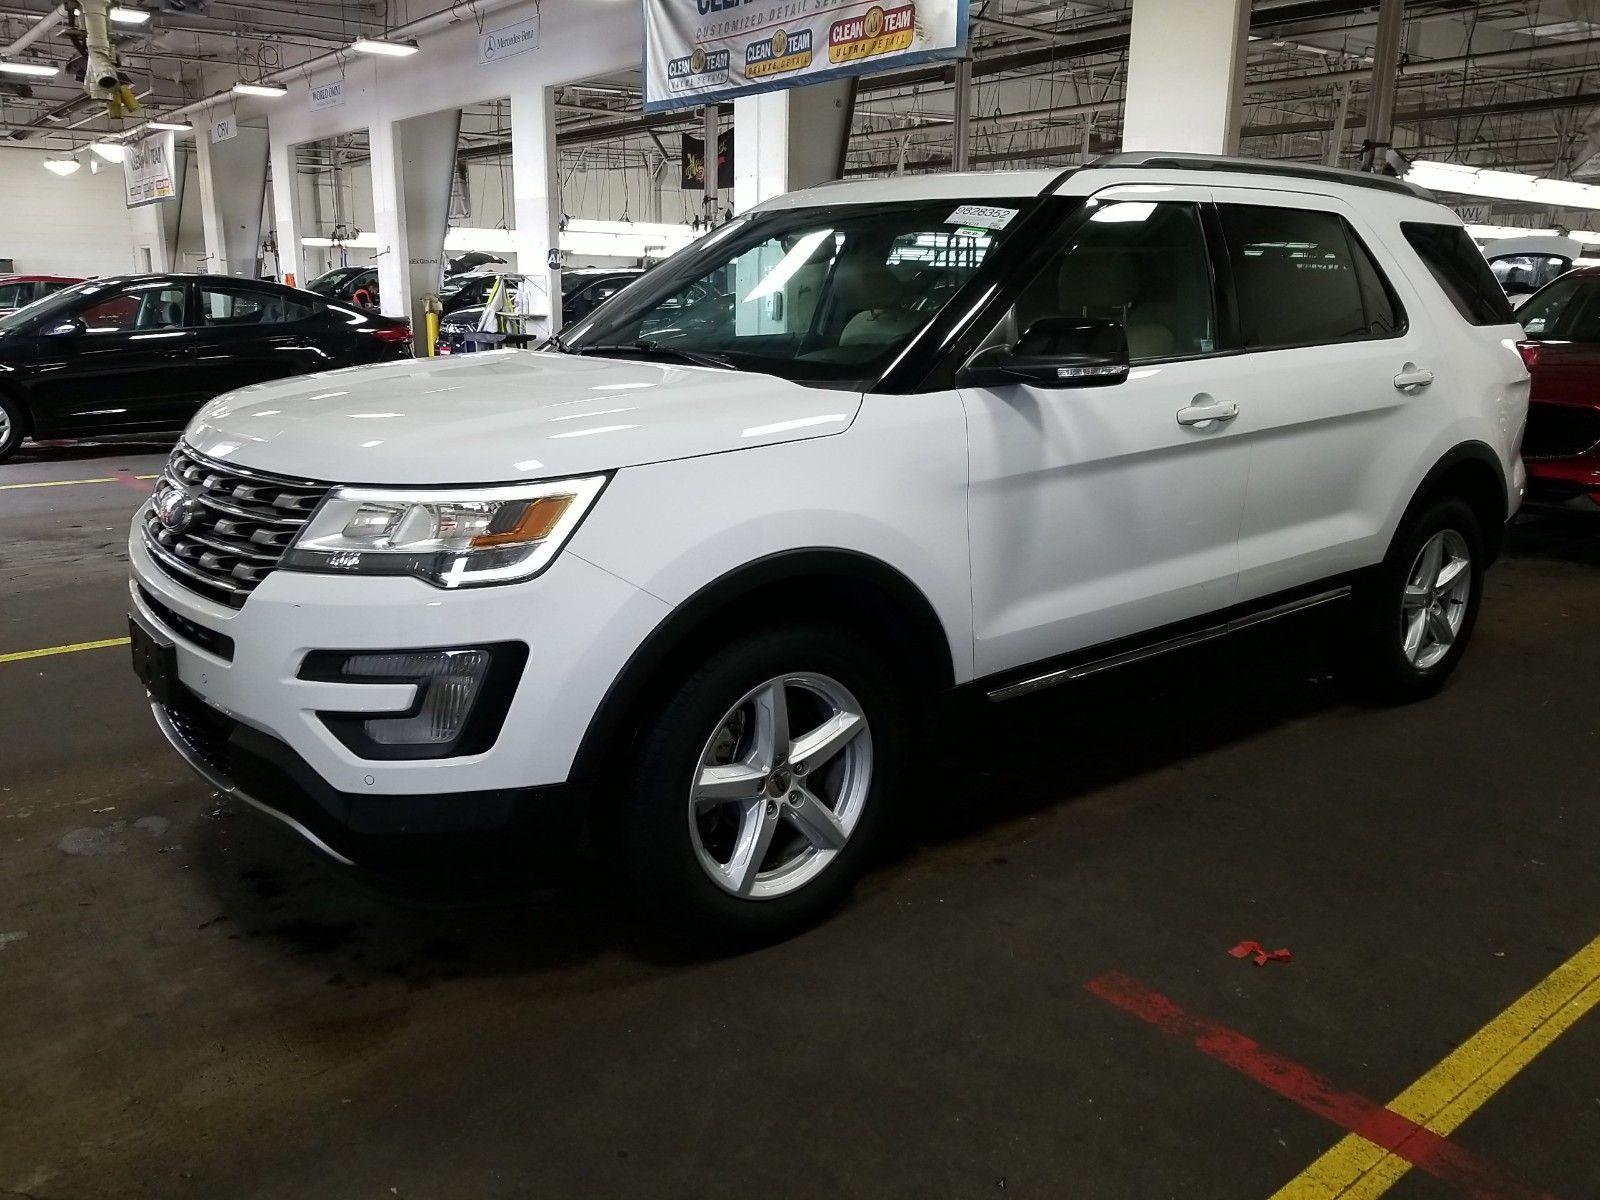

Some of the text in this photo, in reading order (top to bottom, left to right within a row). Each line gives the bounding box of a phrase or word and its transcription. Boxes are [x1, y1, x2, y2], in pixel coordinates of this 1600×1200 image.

[696, 12, 764, 40] CUSTOMIZED
[769, 2, 807, 20] DETAIL
[832, 20, 864, 43] CLEAN
[884, 9, 912, 32] TEAM
[497, 29, 534, 49] Mercedes-Benz
[747, 41, 771, 62] CLEAN
[788, 32, 811, 53] TEAM
[836, 35, 906, 57] ULTRA DETAIL
[668, 59, 690, 77] CLEAN
[706, 53, 728, 70] TEAM
[748, 62, 777, 75] DELUXE
[955, 206, 1011, 219] 9828352
